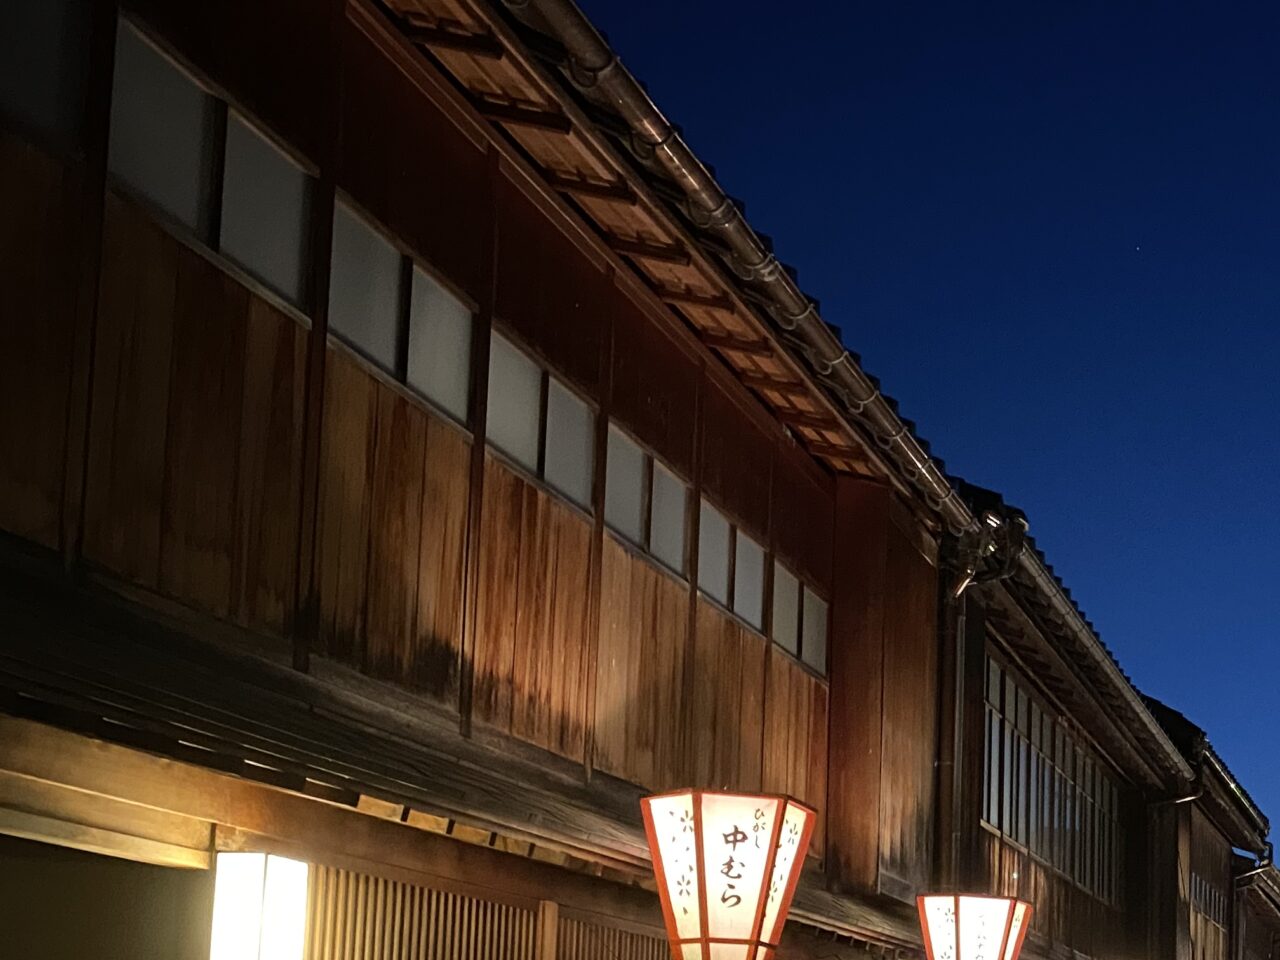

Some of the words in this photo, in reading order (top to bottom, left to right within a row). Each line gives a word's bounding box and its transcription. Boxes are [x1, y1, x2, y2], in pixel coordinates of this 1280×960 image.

[752, 808, 767, 848] ひがし
[720, 825, 749, 908] 中むら
